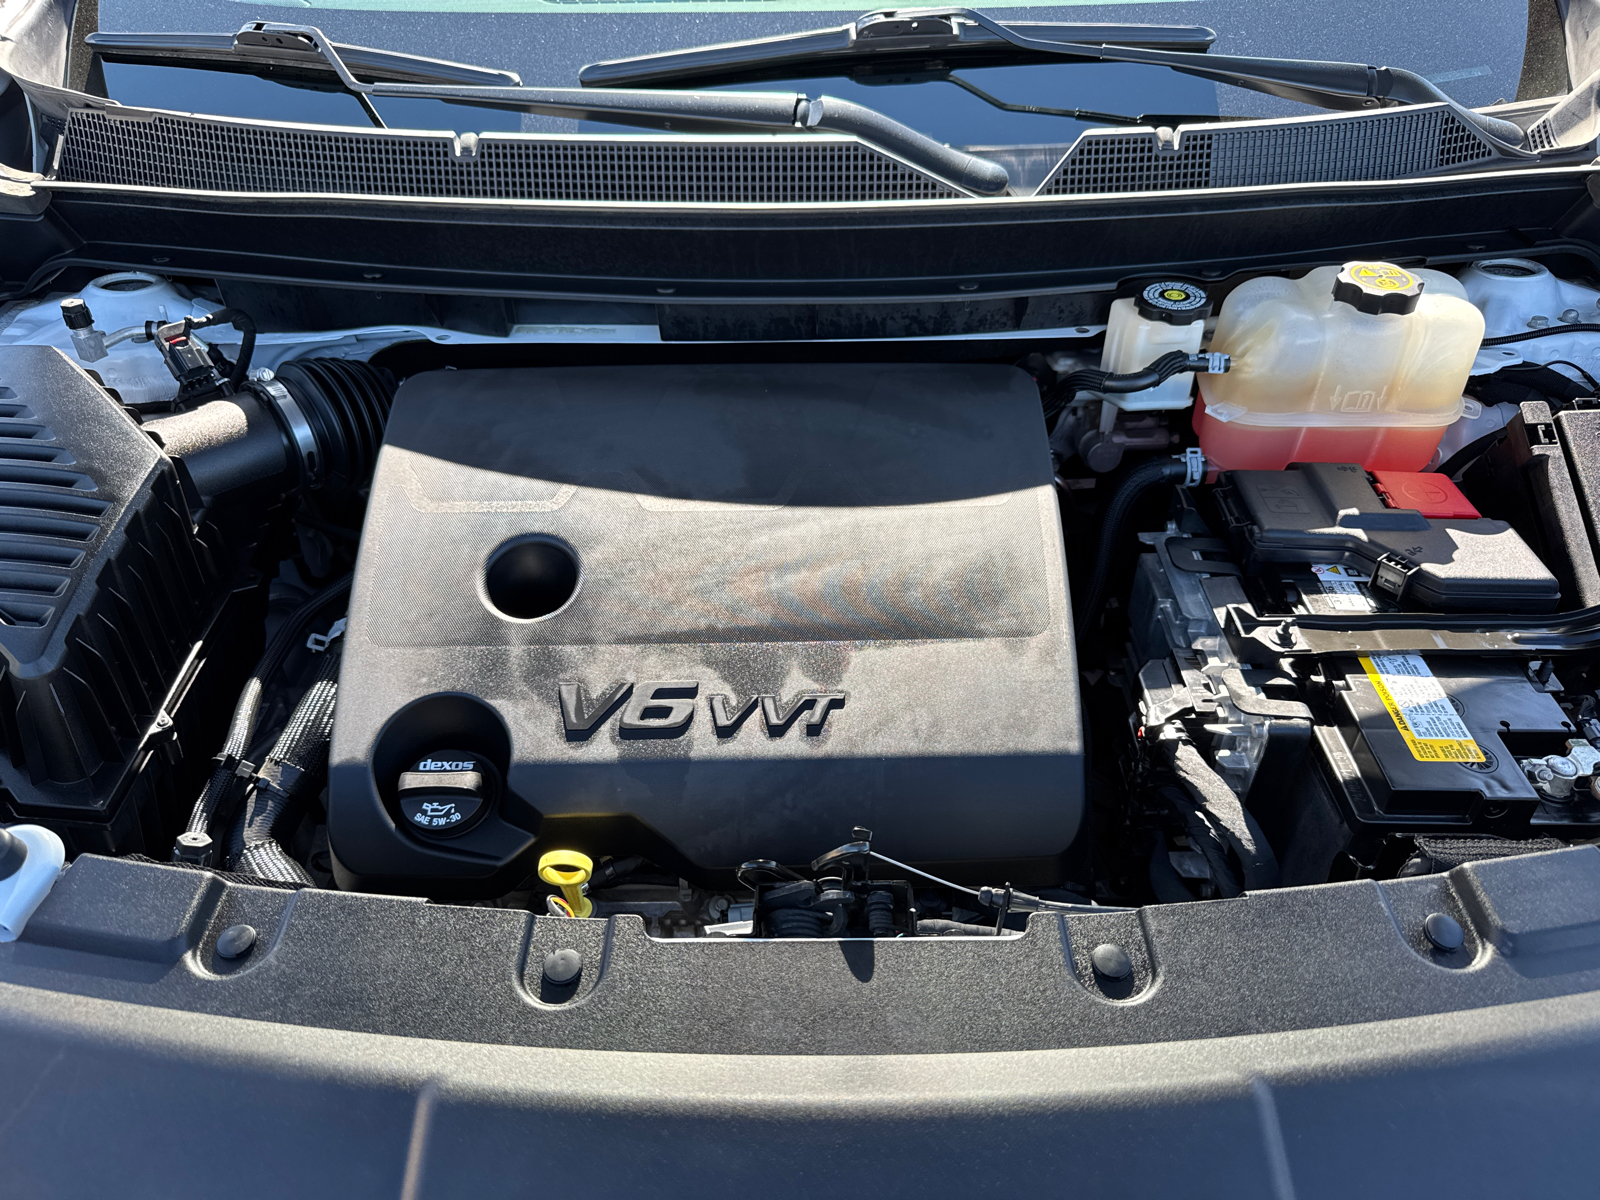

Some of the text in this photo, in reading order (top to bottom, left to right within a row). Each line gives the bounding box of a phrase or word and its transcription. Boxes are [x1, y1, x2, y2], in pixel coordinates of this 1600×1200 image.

[559, 681, 846, 742] V6 VVT
[1387, 701, 1406, 726] DANGER
[419, 759, 476, 771] dexos
[414, 812, 462, 826] SAE 5W-30
